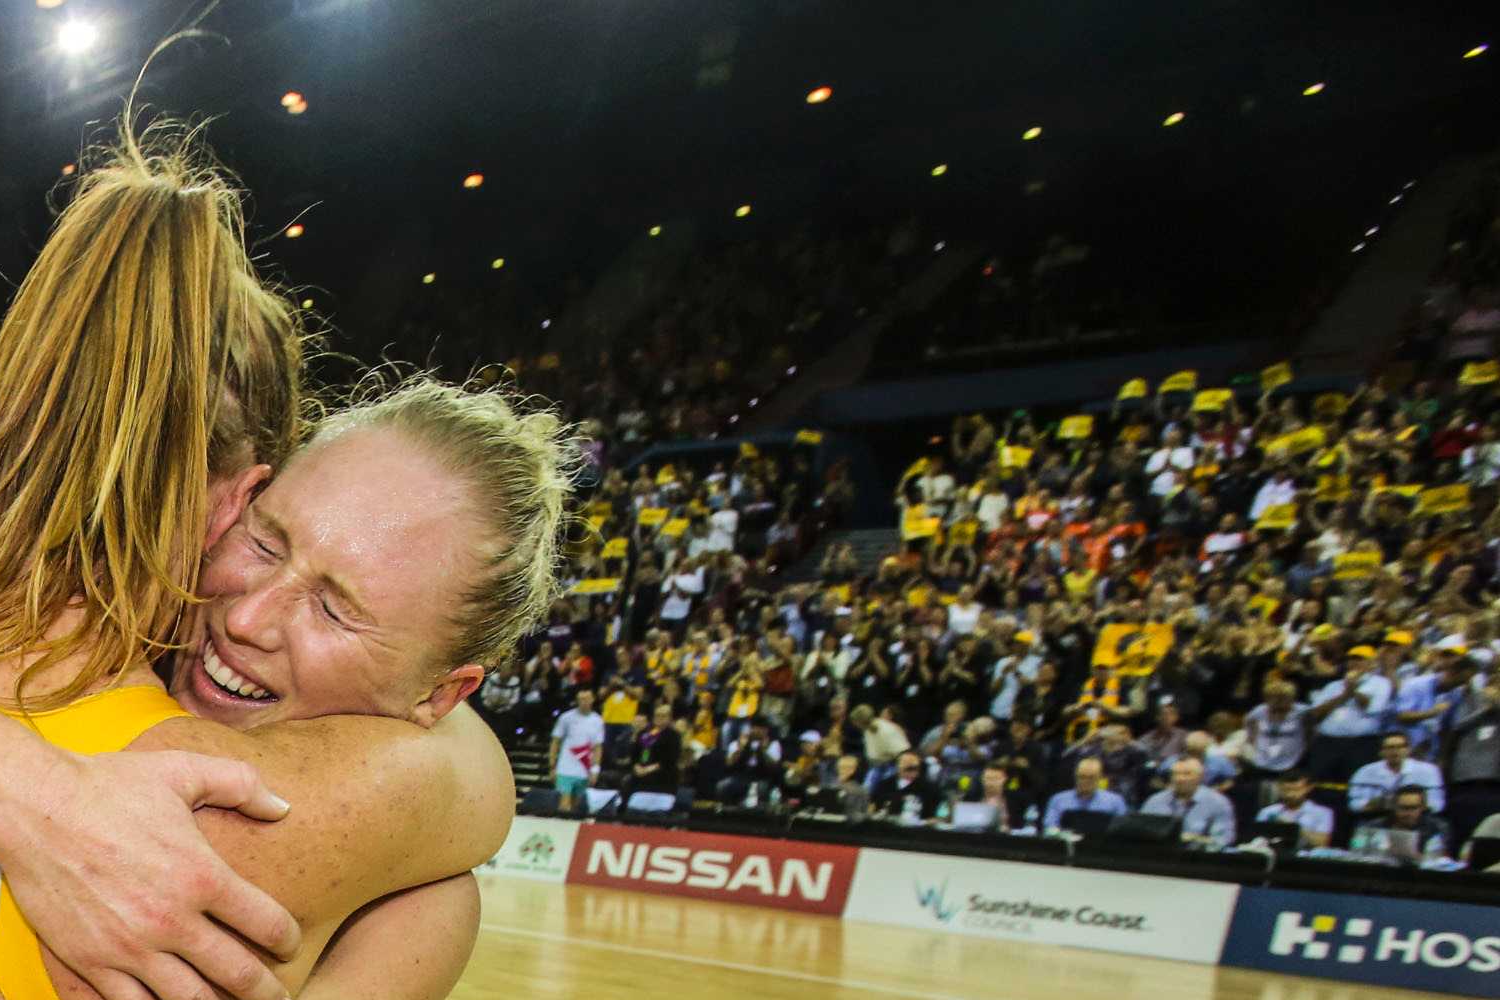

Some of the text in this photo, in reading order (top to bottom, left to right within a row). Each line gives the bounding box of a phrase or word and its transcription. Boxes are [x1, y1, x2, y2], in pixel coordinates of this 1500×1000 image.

[586, 839, 834, 901] NISSAN
[967, 894, 1147, 930] Sunshine Coast
[1374, 926, 1500, 973] HOS
